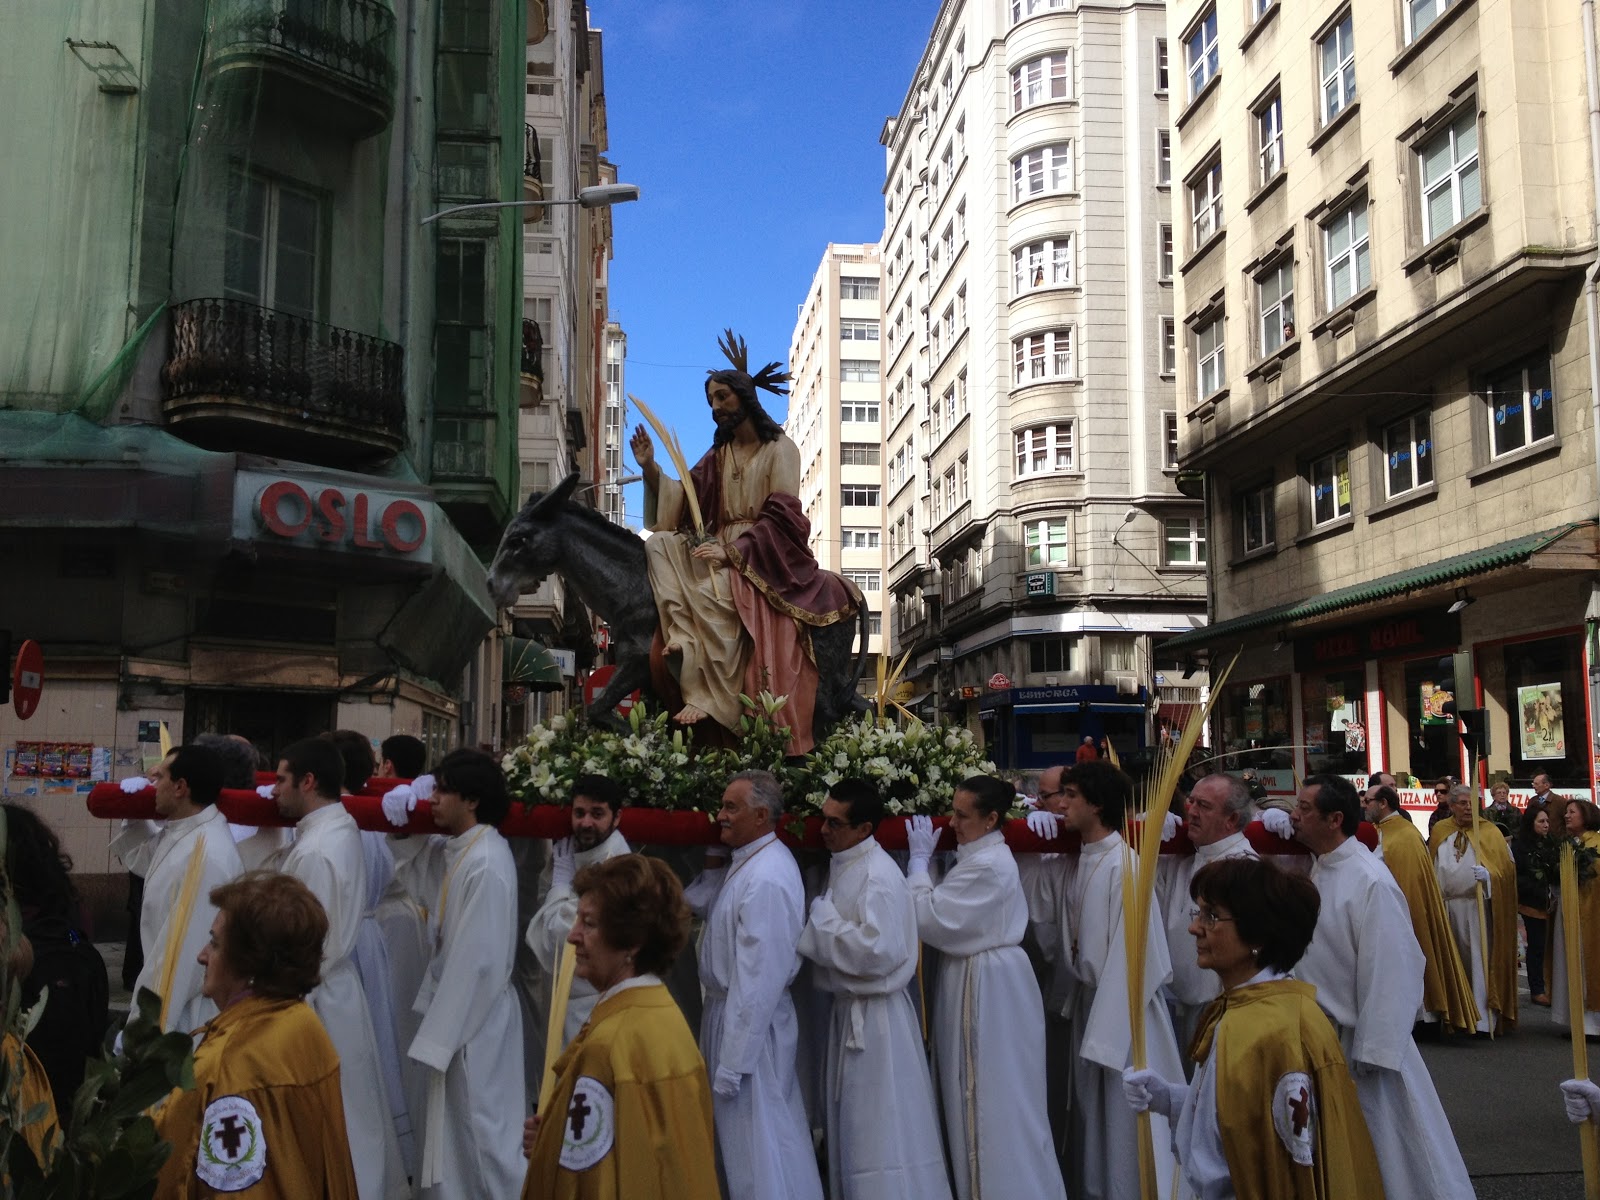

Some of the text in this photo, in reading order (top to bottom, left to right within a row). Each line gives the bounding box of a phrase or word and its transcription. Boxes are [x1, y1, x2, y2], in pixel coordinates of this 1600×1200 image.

[257, 480, 427, 553] OSLO
[1018, 688, 1079, 700] ESMORGA
[1399, 792, 1420, 805] IZZA
